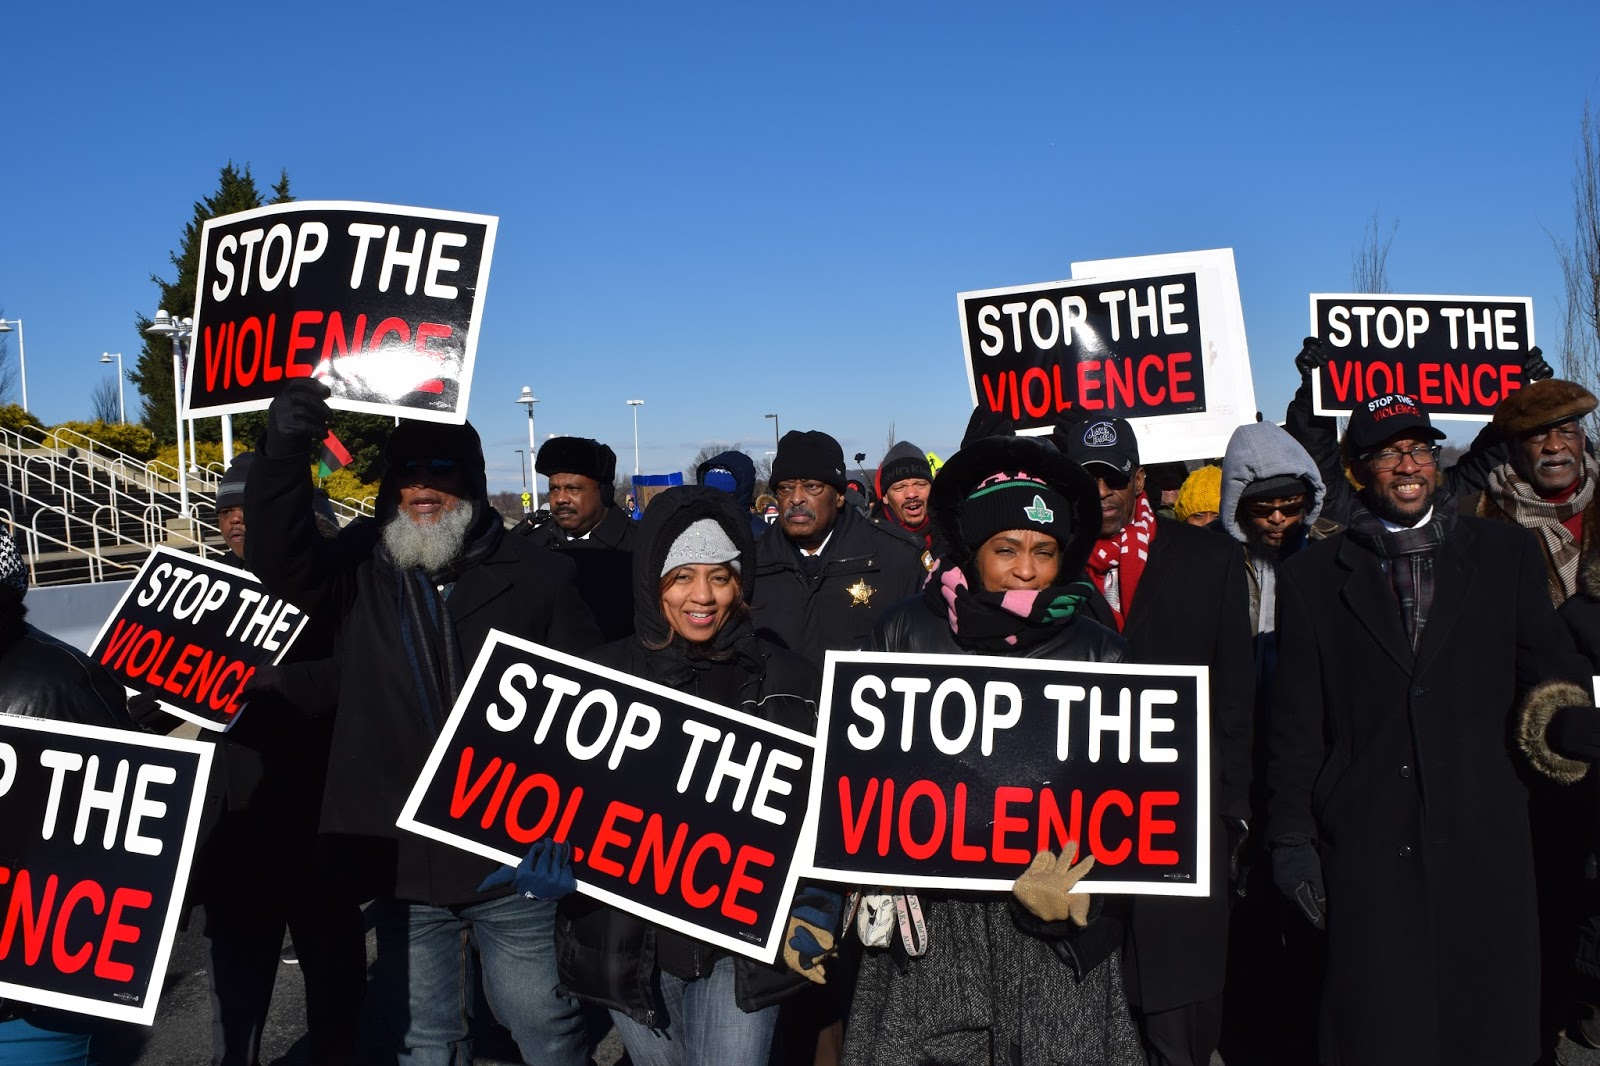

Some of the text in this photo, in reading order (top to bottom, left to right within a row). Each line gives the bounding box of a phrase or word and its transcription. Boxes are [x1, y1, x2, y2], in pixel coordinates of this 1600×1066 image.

[212, 221, 468, 302] STOP THE
[977, 283, 1189, 357] STOP THE
[1328, 305, 1519, 350] STOP THE
[982, 351, 1196, 421] VIOLENCE
[1328, 360, 1522, 407] VIOLENCE
[1368, 394, 1415, 412] STOP THE
[1373, 404, 1421, 422] VIOLENCE
[137, 562, 300, 652] STOP THE
[486, 663, 803, 826] STOP THE
[847, 674, 1179, 764] STOP THE
[40, 749, 177, 857] THE
[449, 746, 775, 925] VIOLENCE
[838, 775, 1180, 866] VIOLENCE
[0, 866, 153, 983] NCE
[899, 910, 907, 926] AKA
